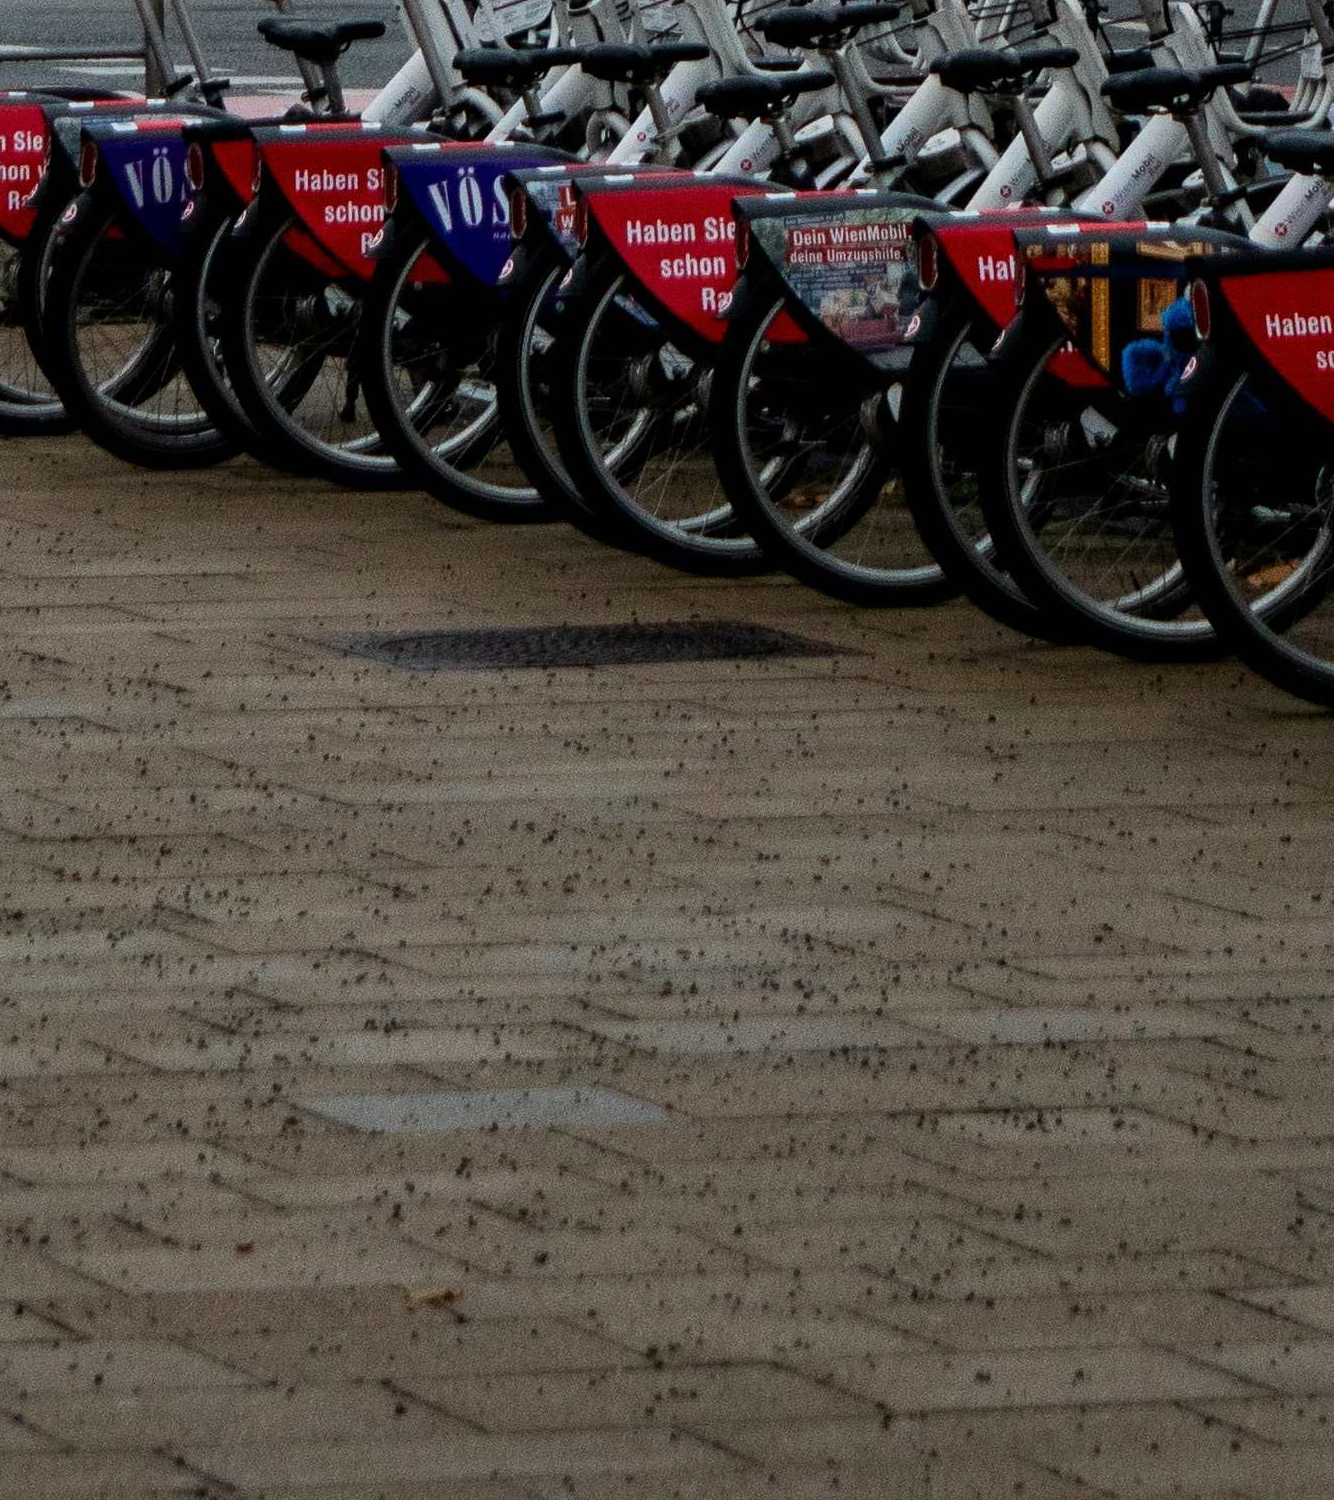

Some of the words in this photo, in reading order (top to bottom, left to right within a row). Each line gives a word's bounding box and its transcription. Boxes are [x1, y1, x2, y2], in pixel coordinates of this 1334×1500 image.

[13, 131, 44, 151] Sie
[294, 168, 359, 192] Haben
[323, 200, 385, 224] schon
[625, 219, 696, 245] Haben
[703, 216, 736, 242] Sie
[792, 228, 827, 247] Dein
[829, 224, 913, 244] WienMobil,
[659, 253, 727, 279] schon
[789, 250, 823, 264] deine
[826, 246, 905, 265] Umzugshilfe.
[1265, 312, 1332, 338] Haben
